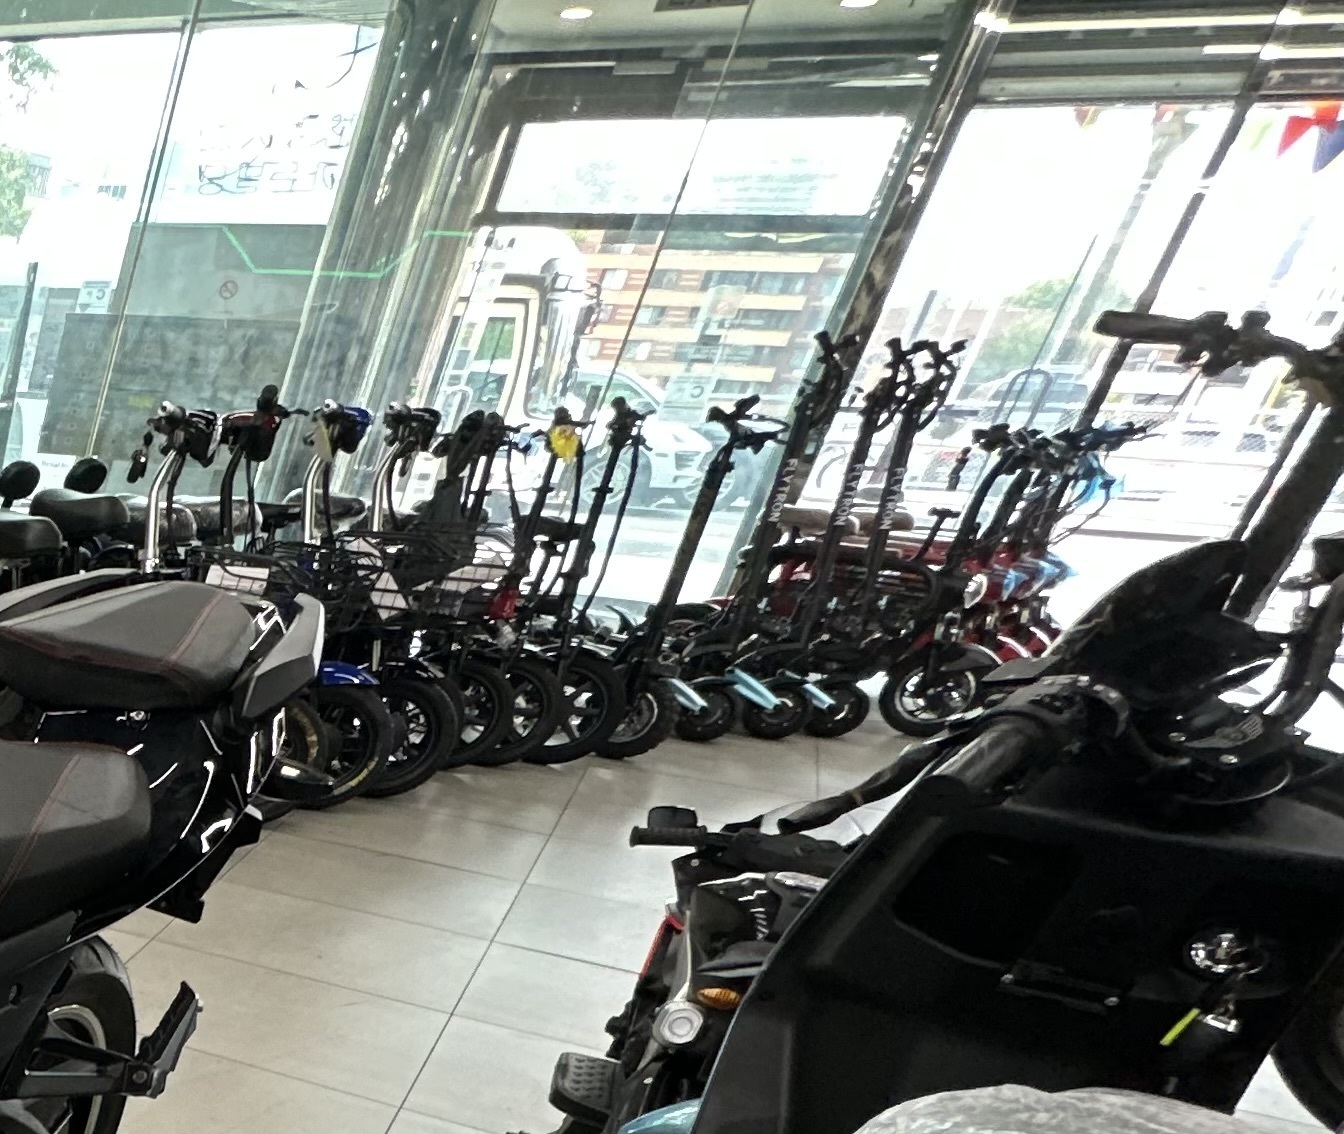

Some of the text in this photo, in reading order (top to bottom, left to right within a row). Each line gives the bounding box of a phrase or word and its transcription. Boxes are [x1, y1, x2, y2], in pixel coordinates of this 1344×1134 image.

[768, 458, 799, 523] FLYTRON
[833, 463, 862, 527] FLYTRON
[879, 467, 906, 530] FLYTRON
